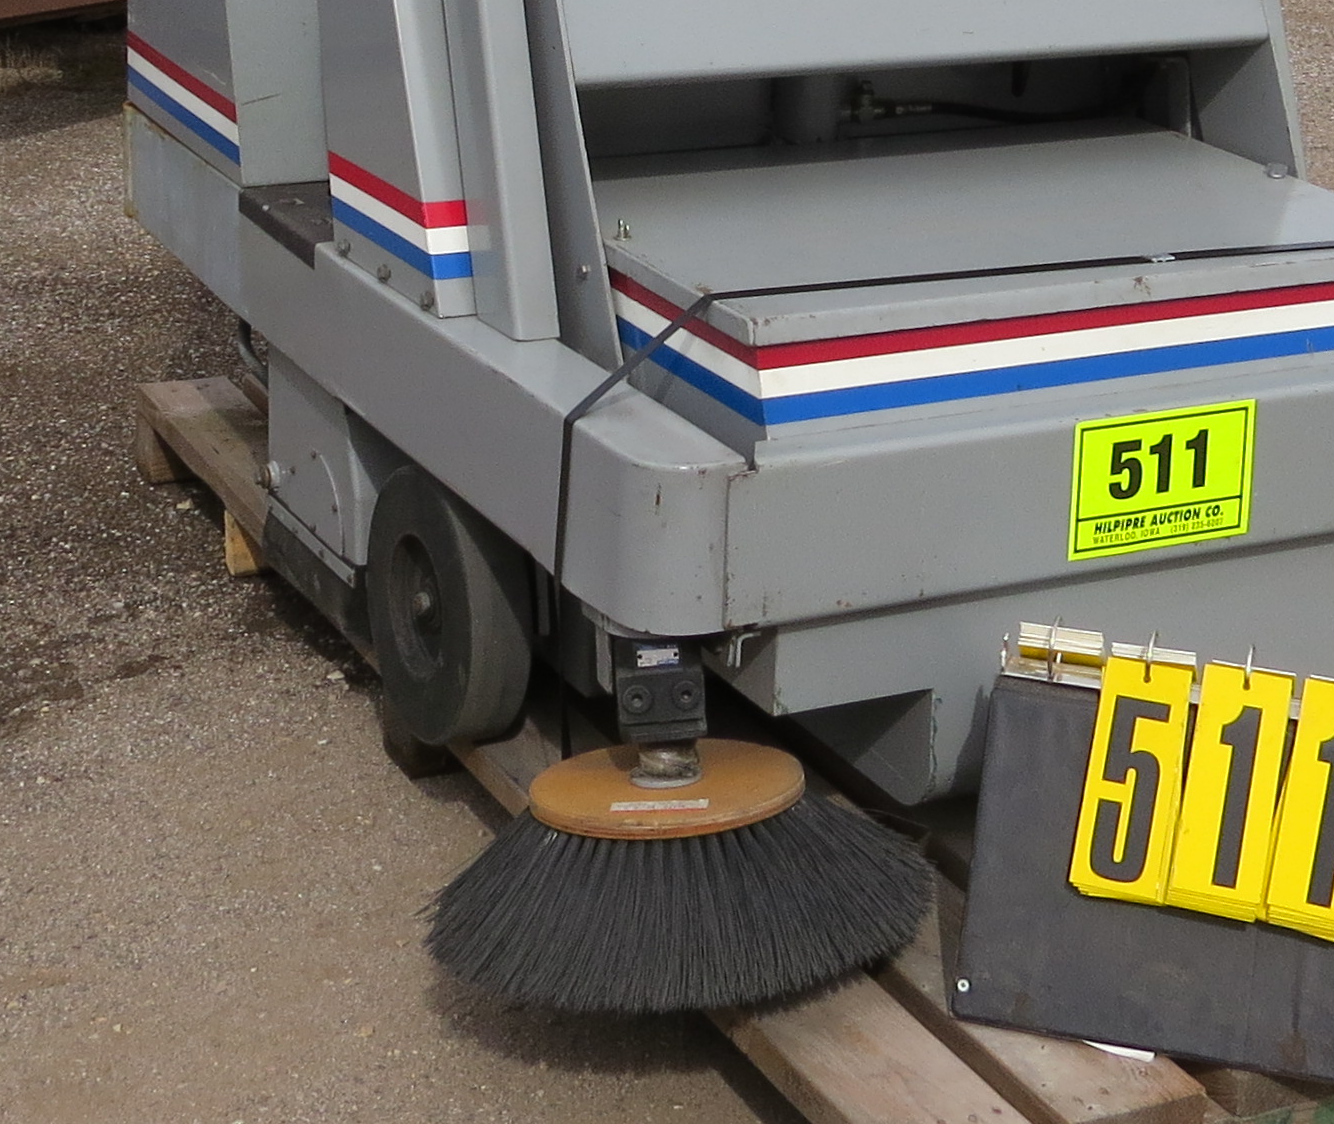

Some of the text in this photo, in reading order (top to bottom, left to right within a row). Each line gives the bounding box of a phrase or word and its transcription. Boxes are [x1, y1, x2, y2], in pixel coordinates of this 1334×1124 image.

[1108, 428, 1209, 501] 511
[1094, 504, 1225, 536] HILPIPRE AUCTION CO.
[1140, 527, 1161, 538] IOWA
